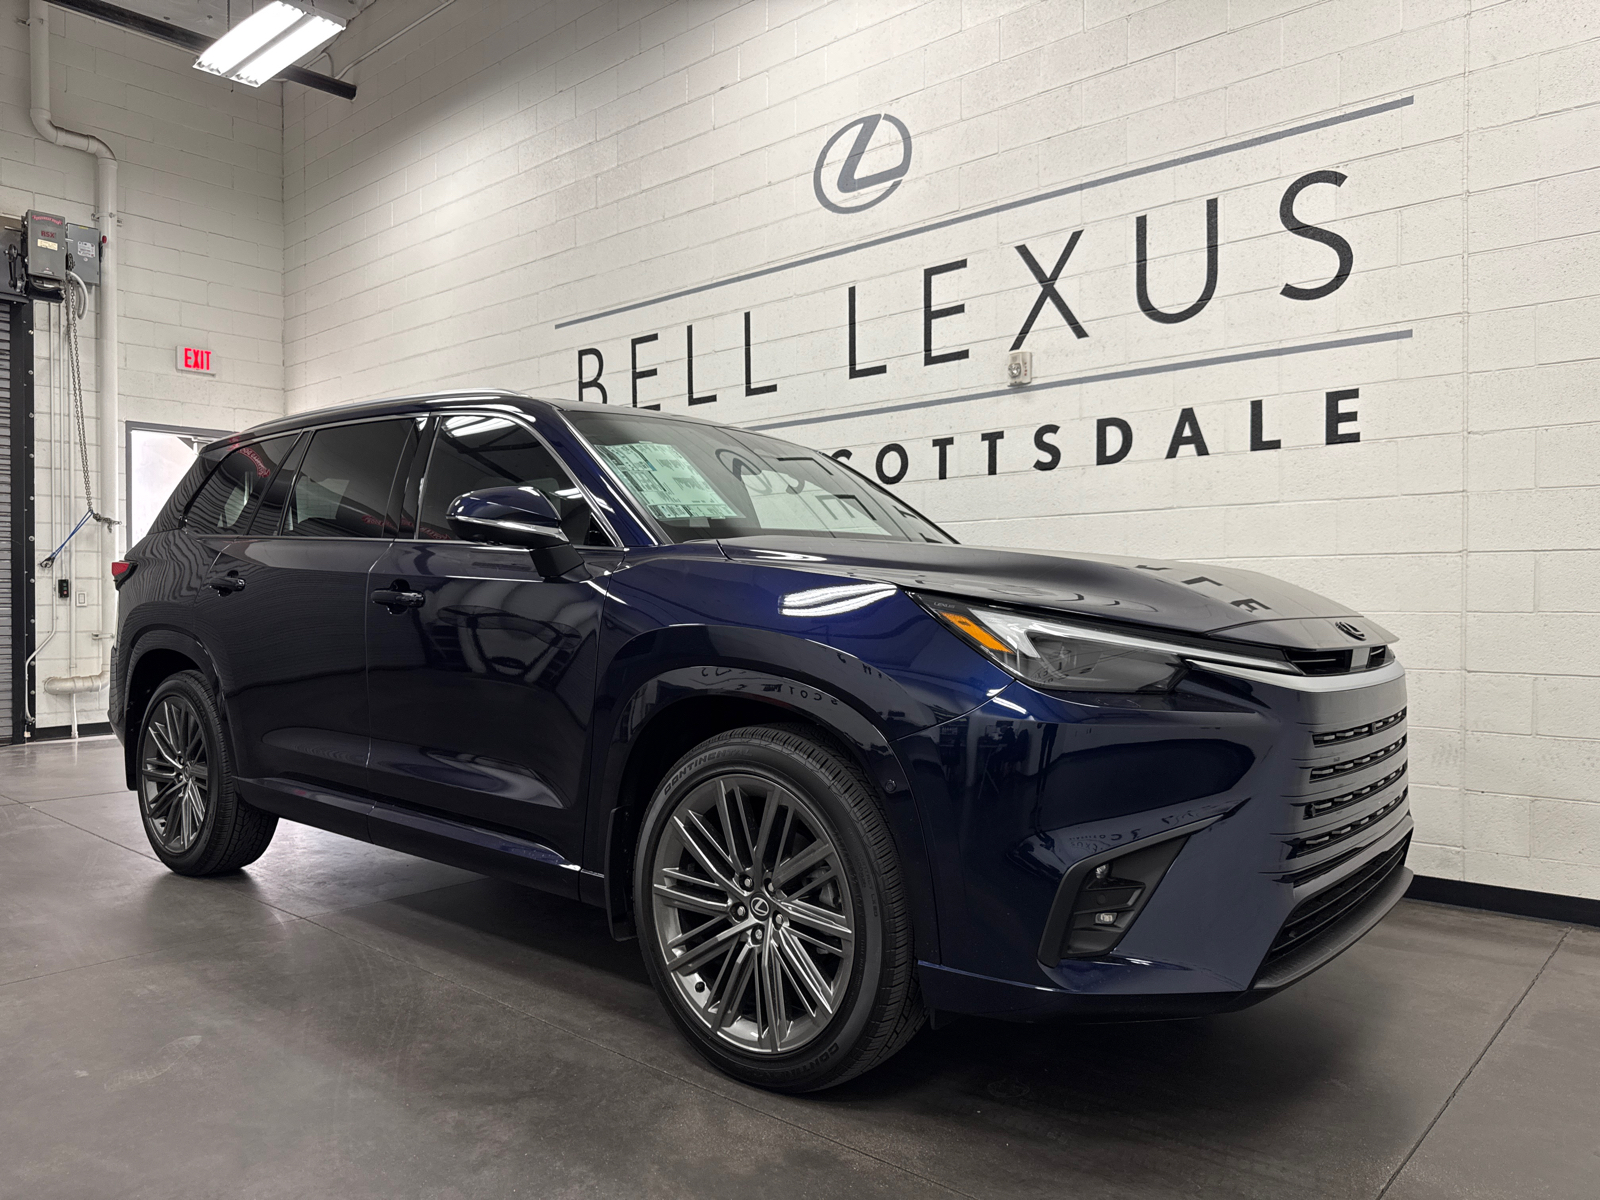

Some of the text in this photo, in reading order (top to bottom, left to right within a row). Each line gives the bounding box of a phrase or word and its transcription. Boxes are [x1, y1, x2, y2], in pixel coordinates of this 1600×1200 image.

[578, 170, 1354, 411] BELL LEXUS
[184, 347, 211, 371] EXIT
[664, 748, 753, 796] CONTINENTAL
